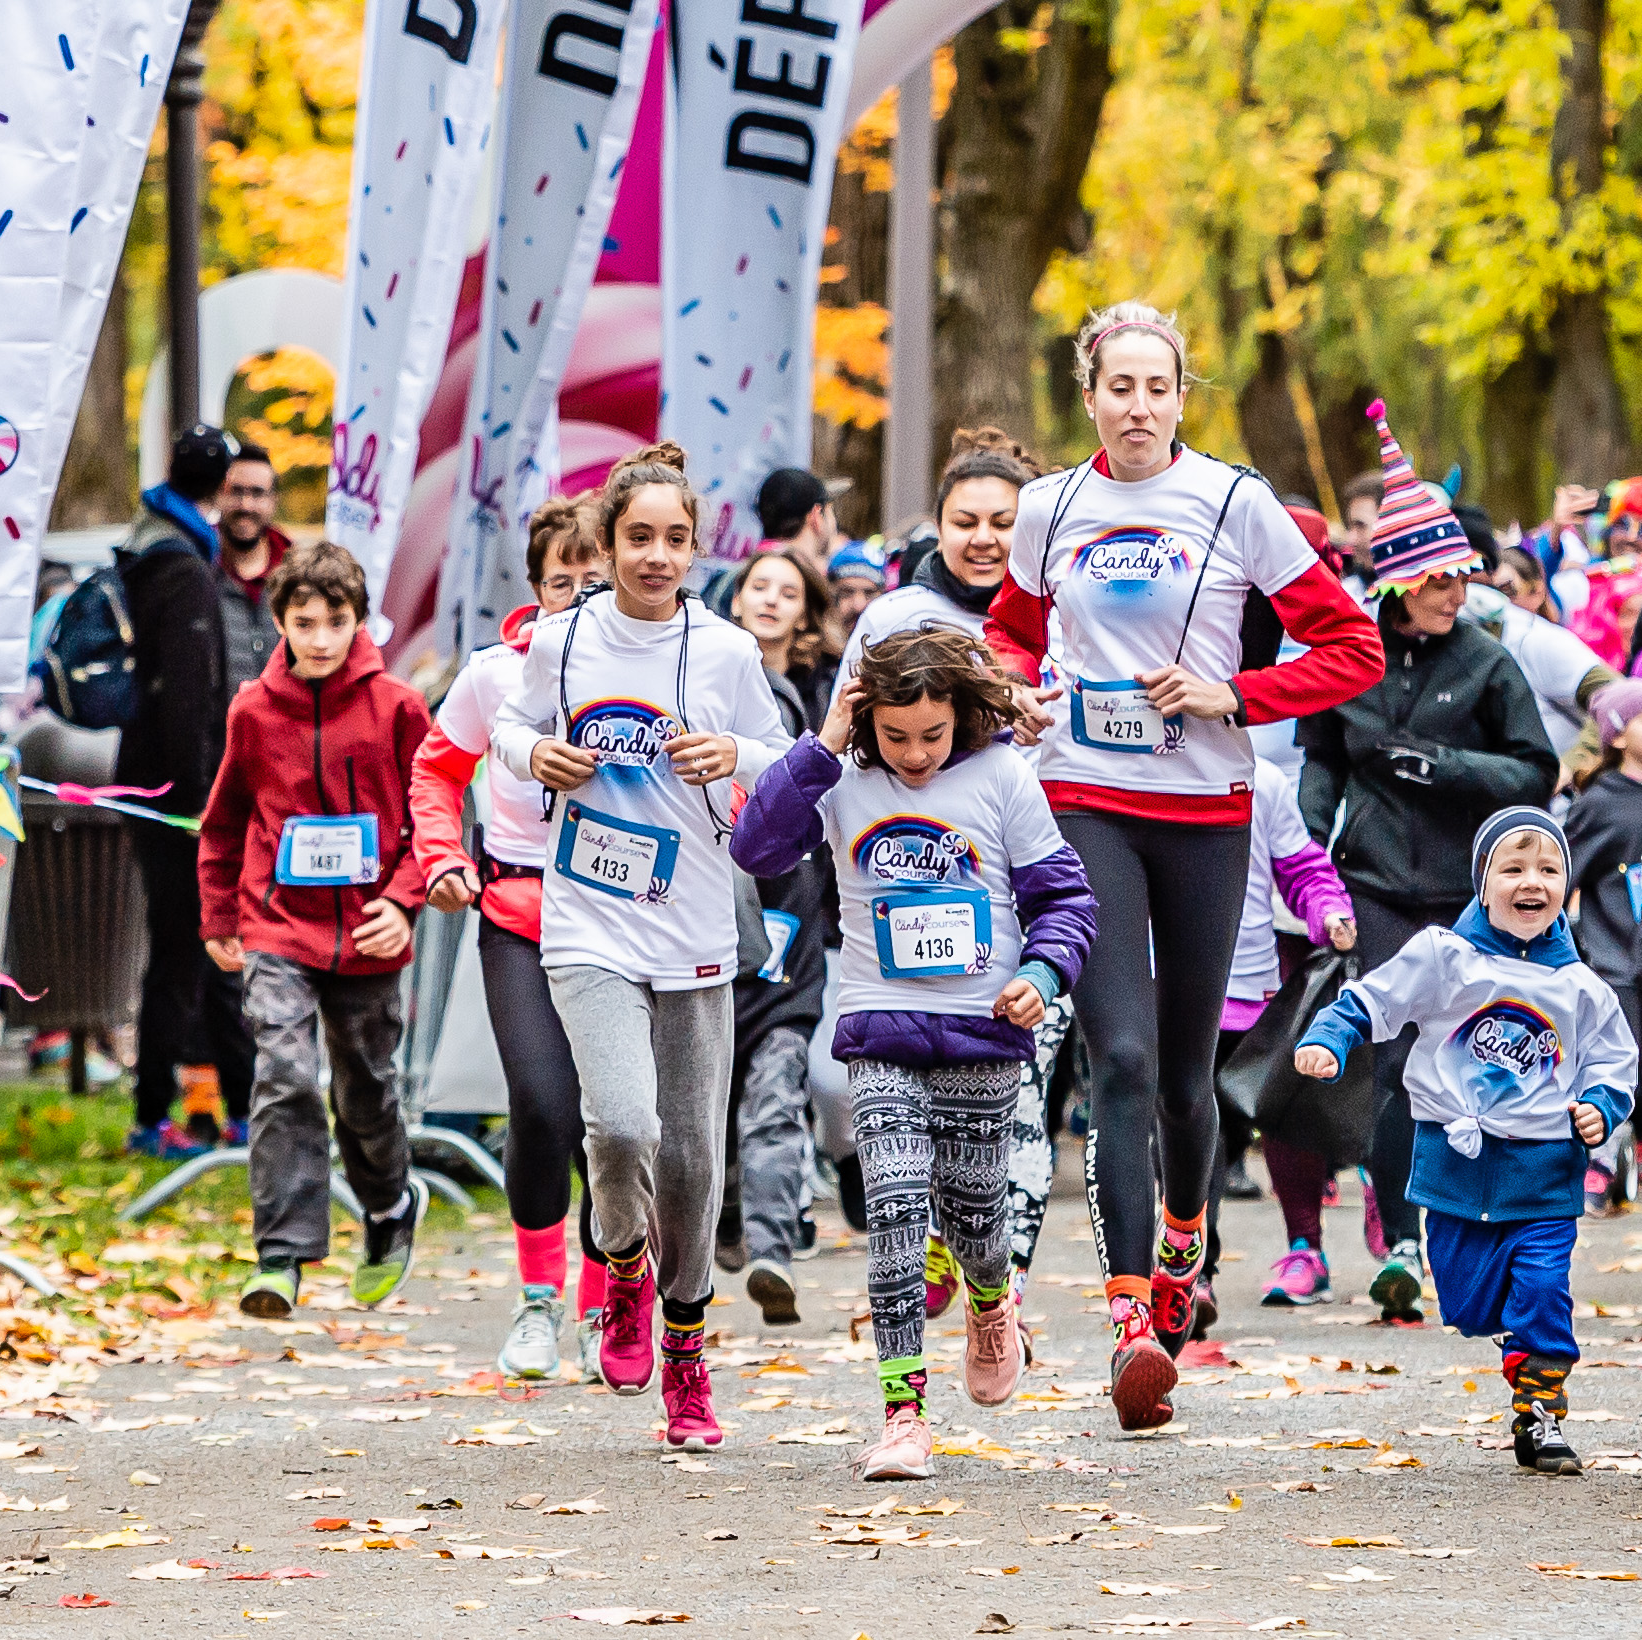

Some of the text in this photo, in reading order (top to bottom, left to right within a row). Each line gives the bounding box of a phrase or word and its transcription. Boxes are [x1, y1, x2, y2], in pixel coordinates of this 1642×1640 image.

[1090, 547, 1164, 578] Candy
[584, 722, 660, 765] Candy
[1103, 720, 1143, 739] 4279
[590, 855, 630, 882] 4133
[874, 839, 950, 881] Candy
[894, 869, 936, 880] course
[894, 917, 960, 934] Candy course
[914, 937, 954, 960] 4136
[1474, 1019, 1538, 1075] Candy
[1085, 1128, 1099, 1181] new
